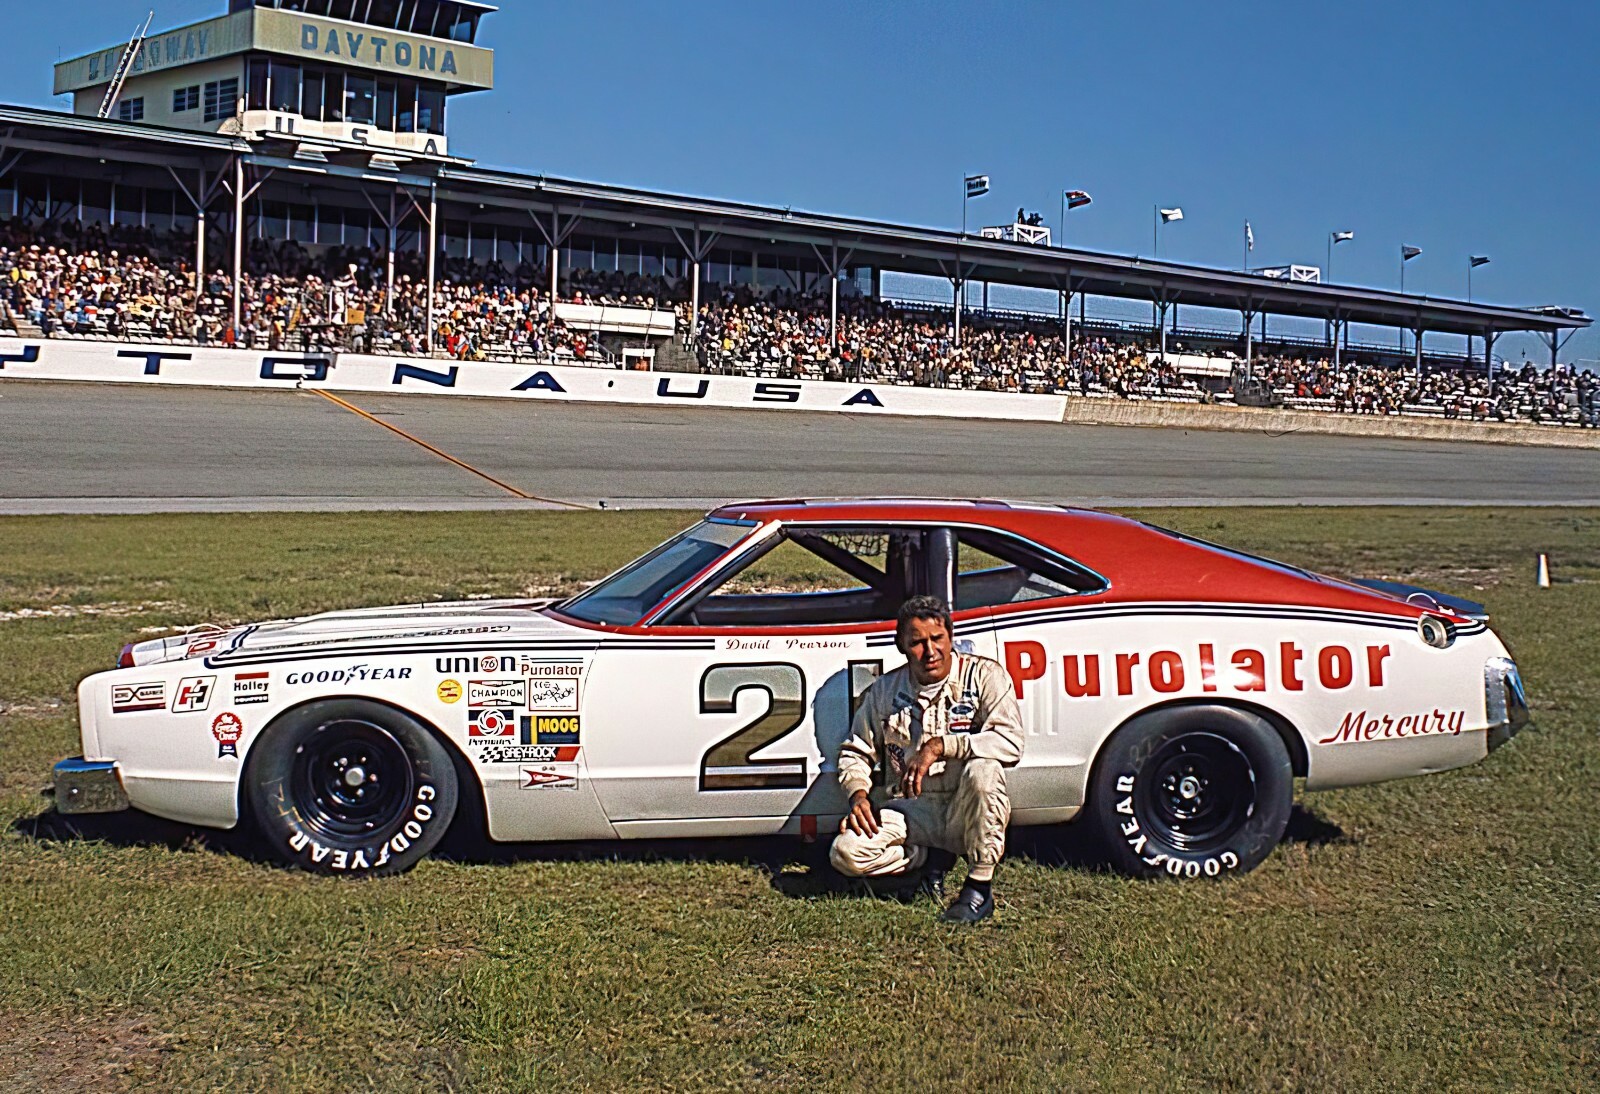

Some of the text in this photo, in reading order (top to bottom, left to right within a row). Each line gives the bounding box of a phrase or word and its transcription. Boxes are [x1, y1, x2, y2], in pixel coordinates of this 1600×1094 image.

[301, 23, 458, 75] DAYTONA
[656, 377, 885, 408] USA
[725, 638, 853, 650] David Pearson
[521, 664, 584, 676] Purolator
[1004, 640, 1391, 699] Purolator
[233, 681, 270, 692] Holley
[471, 689, 523, 698] CHAMPION
[538, 717, 579, 734] MOOG
[1320, 708, 1465, 746] Mercury
[288, 784, 437, 870] GOODYEAR
[1115, 775, 1239, 879] GOODYEAR
